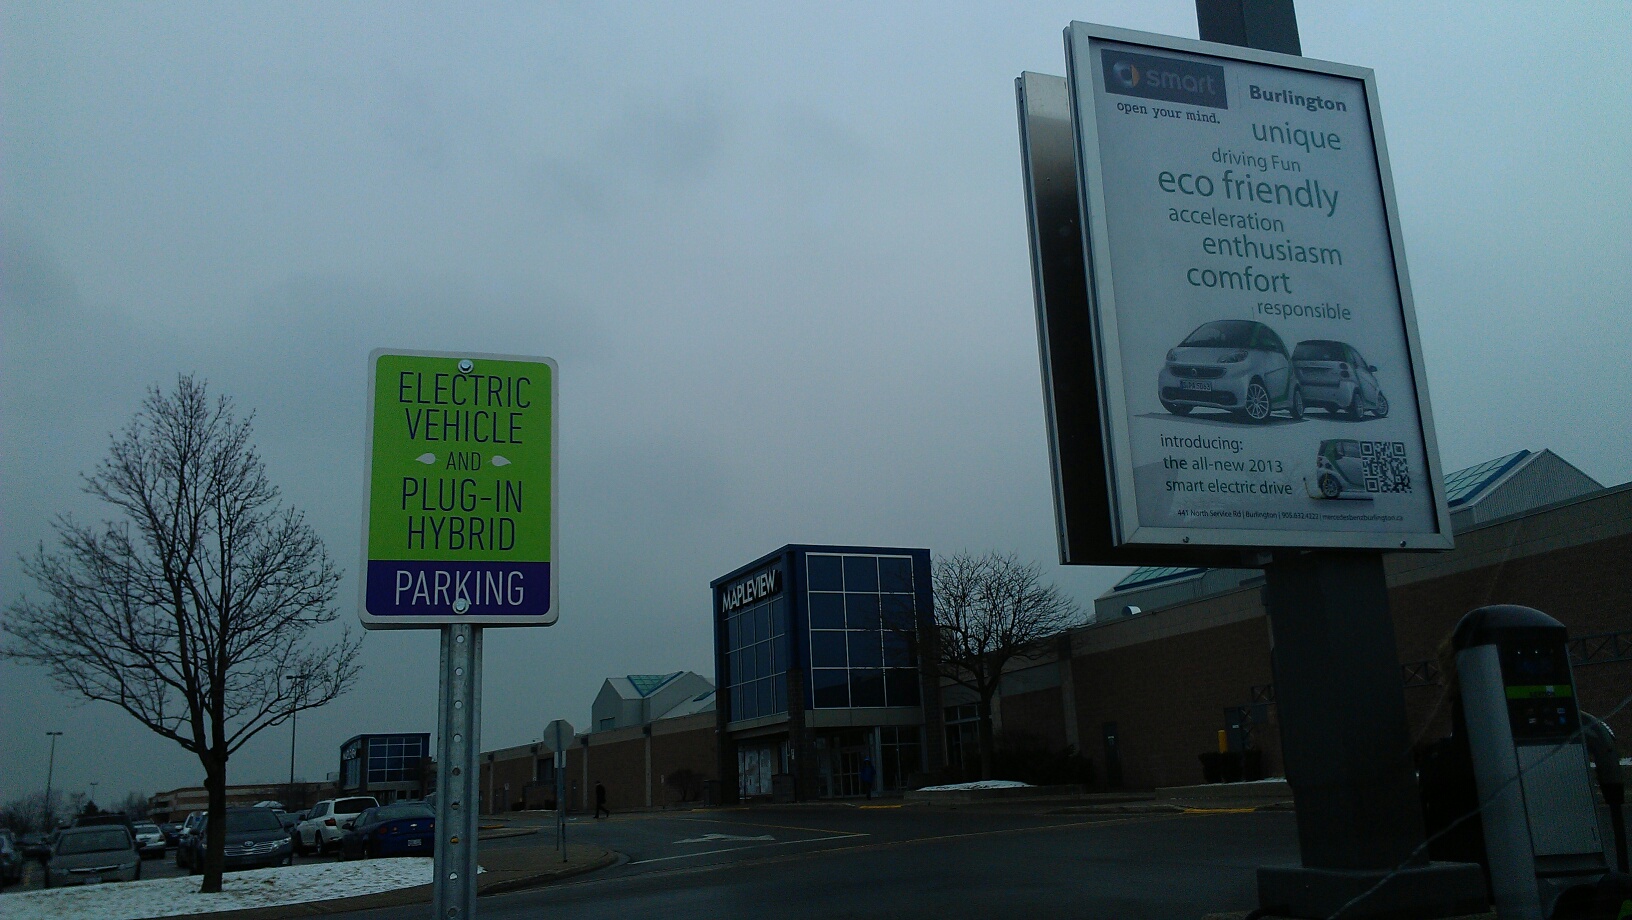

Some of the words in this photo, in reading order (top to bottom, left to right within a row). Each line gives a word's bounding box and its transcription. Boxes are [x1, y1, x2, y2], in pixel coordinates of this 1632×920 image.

[1146, 69, 1216, 95] smart
[1249, 84, 1347, 113] Burlington
[1117, 102, 1147, 115] open
[1152, 107, 1182, 118] your
[1186, 111, 1221, 124] mind.
[1251, 122, 1342, 153] unique
[1211, 148, 1267, 171] driving
[1272, 155, 1301, 173] Fun
[1158, 170, 1214, 197] eco
[1221, 170, 1338, 217] friendly
[1168, 206, 1284, 232] acceleration
[1203, 234, 1342, 265] enthusiasm
[1187, 266, 1292, 294] comfort
[1257, 302, 1351, 321] responsible
[399, 371, 531, 408] ELECTRIC
[405, 408, 523, 444] VEHICLE
[1160, 434, 1244, 453] introducing:
[446, 451, 482, 471] AND
[1163, 456, 1188, 471] the
[1192, 457, 1244, 472] all-new
[1249, 459, 1283, 473] 2013
[402, 477, 522, 513] PLUG-IN
[1165, 480, 1204, 493] smart
[1208, 480, 1256, 494] electric
[1259, 481, 1292, 495] drive
[1190, 509, 1209, 518] North
[1210, 510, 1232, 518] Service
[1245, 511, 1278, 520] Burlington
[407, 516, 516, 551] HYBRID
[395, 570, 525, 606] PARKING
[722, 567, 776, 613] MAPLEVIEW
